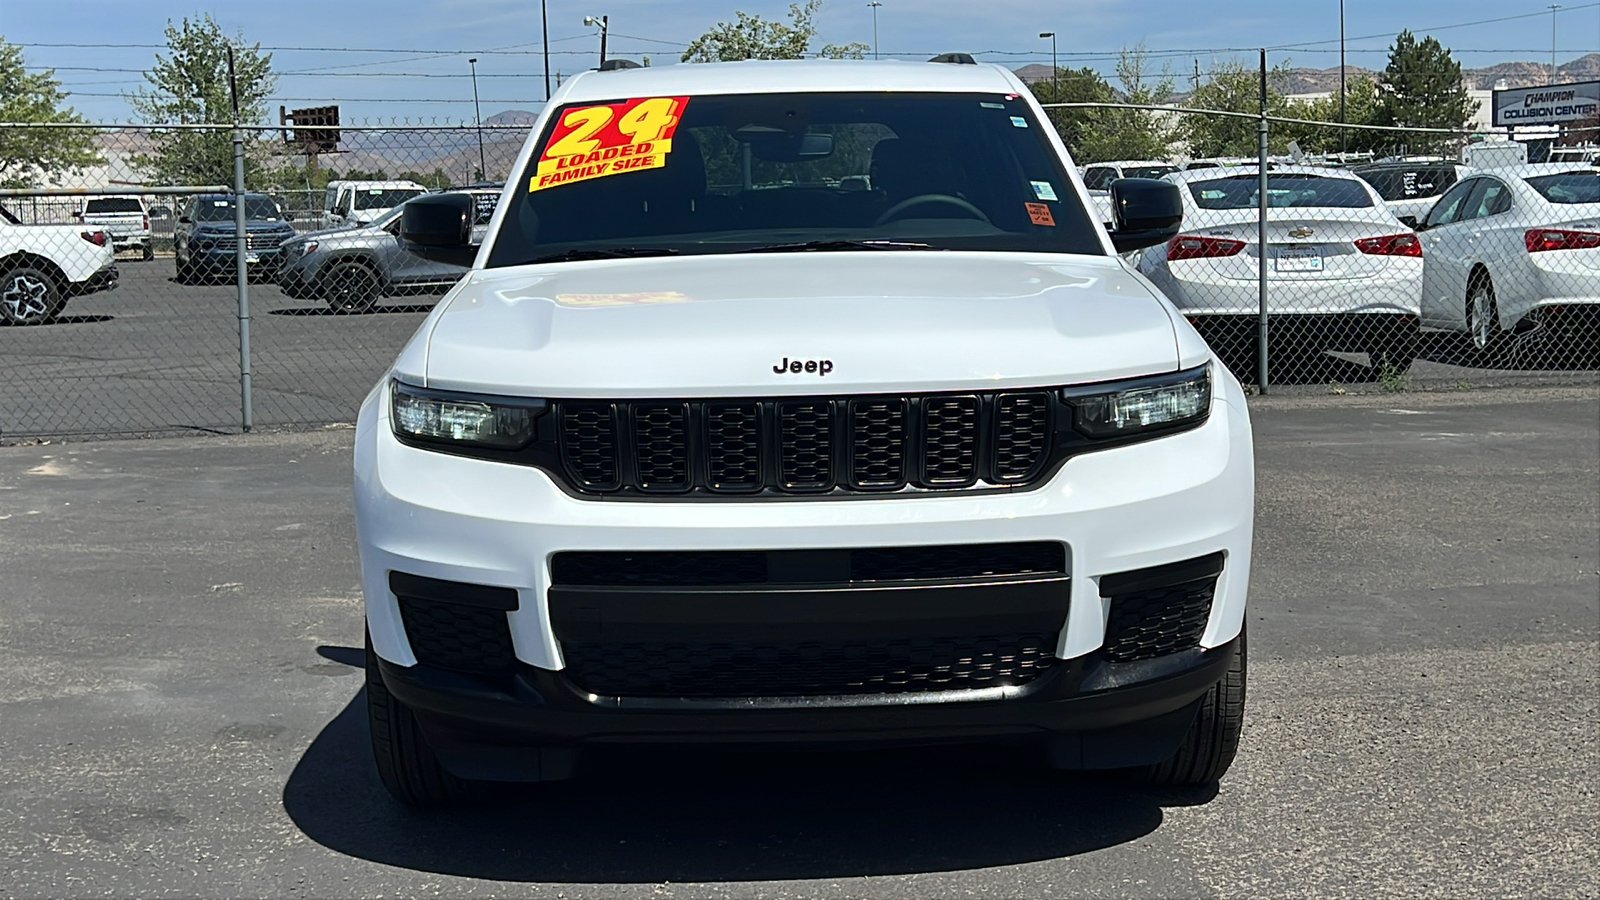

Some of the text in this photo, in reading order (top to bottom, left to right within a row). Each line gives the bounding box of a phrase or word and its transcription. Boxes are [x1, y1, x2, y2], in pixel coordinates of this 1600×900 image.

[1524, 90, 1575, 107] CHAMPION
[1504, 104, 1596, 119] COLLISION CENTER
[546, 98, 678, 158] 24
[556, 142, 653, 170] LOADED
[538, 155, 656, 187] FAMILY SIZE
[773, 357, 833, 377] Jeep
